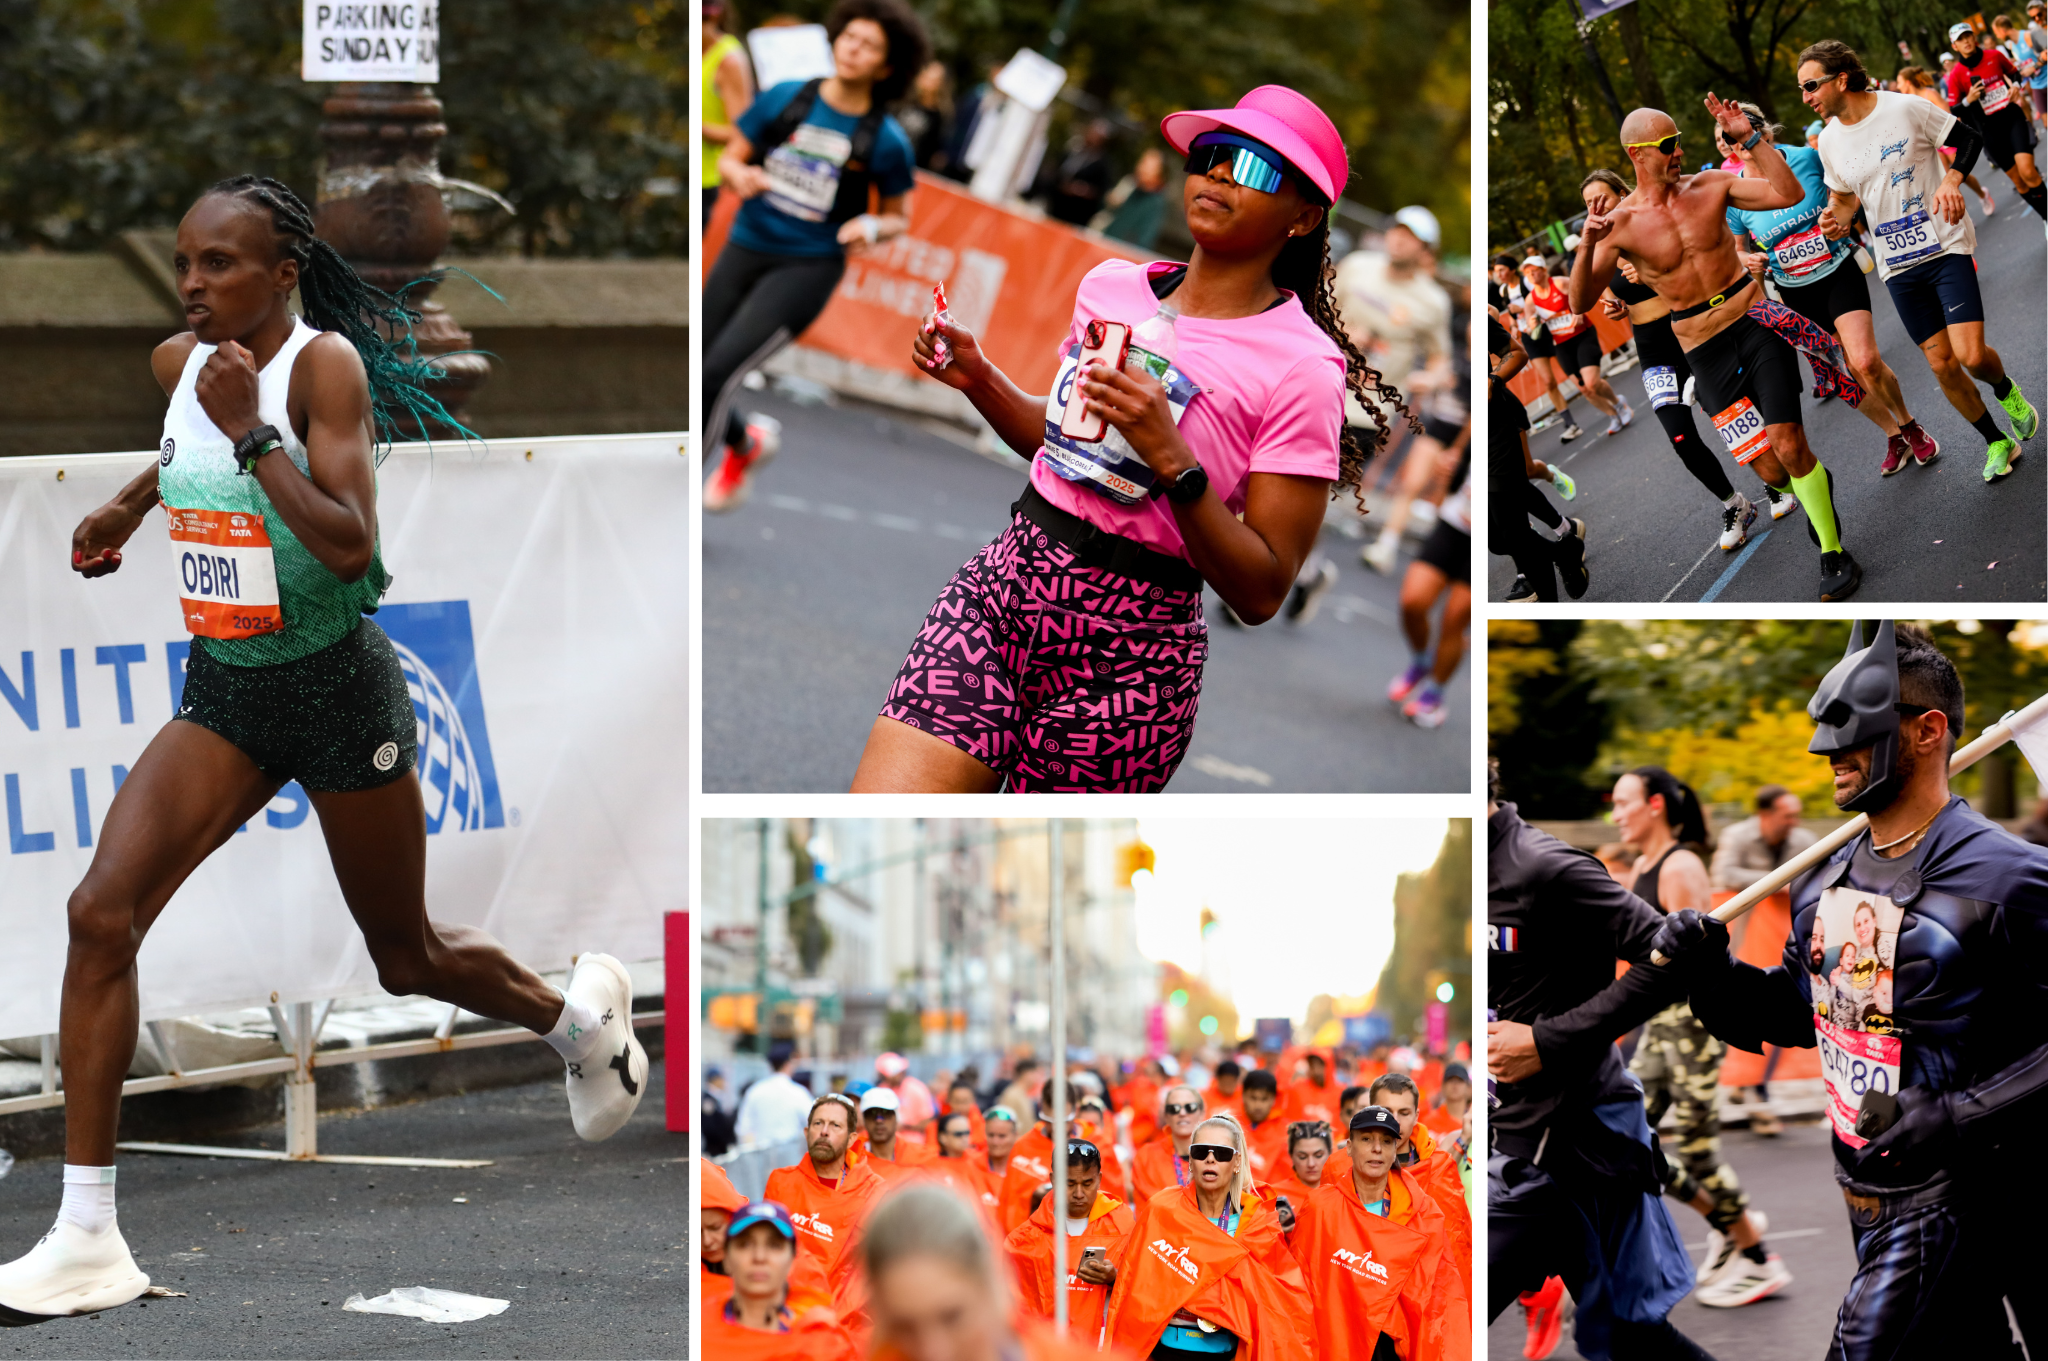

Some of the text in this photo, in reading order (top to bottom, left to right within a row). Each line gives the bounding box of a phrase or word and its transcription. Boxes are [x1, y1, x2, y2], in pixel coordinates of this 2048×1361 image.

[317, 5, 414, 30] PARKING
[321, 37, 412, 62] SUNDAY
[1759, 205, 1823, 243] AUSTRALIA
[1778, 237, 1825, 264] 64655
[1885, 225, 1928, 251] 5055
[1106, 474, 1136, 494] 2025
[229, 529, 252, 537] TATA
[181, 551, 240, 599] OBIRI
[233, 616, 274, 630] 2025
[1864, 1047, 1885, 1060] TATA
